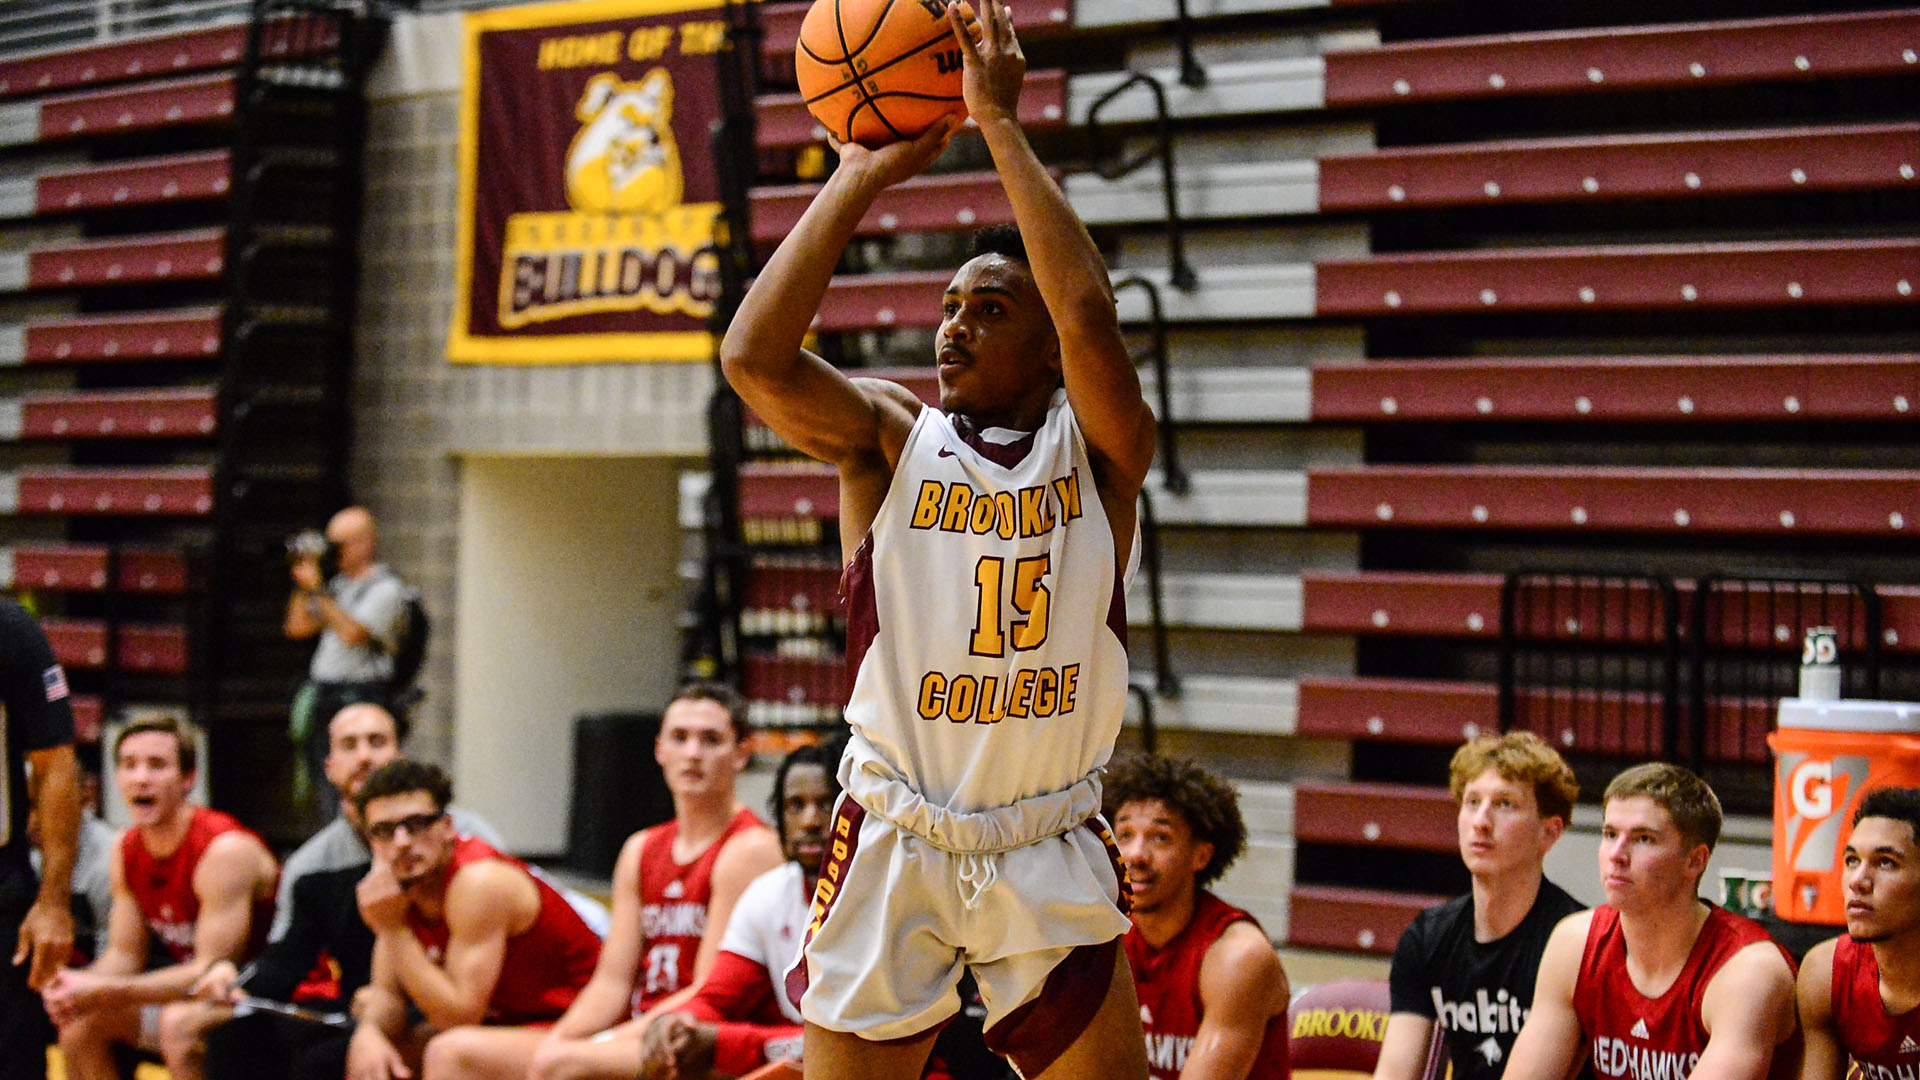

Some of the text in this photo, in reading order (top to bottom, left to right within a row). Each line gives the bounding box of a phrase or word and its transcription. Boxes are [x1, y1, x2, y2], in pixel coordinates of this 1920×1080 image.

[680, 20, 733, 55] TH
[512, 247, 718, 312] BULLDOG
[968, 551, 1051, 658] 15
[1792, 762, 1833, 819] G
